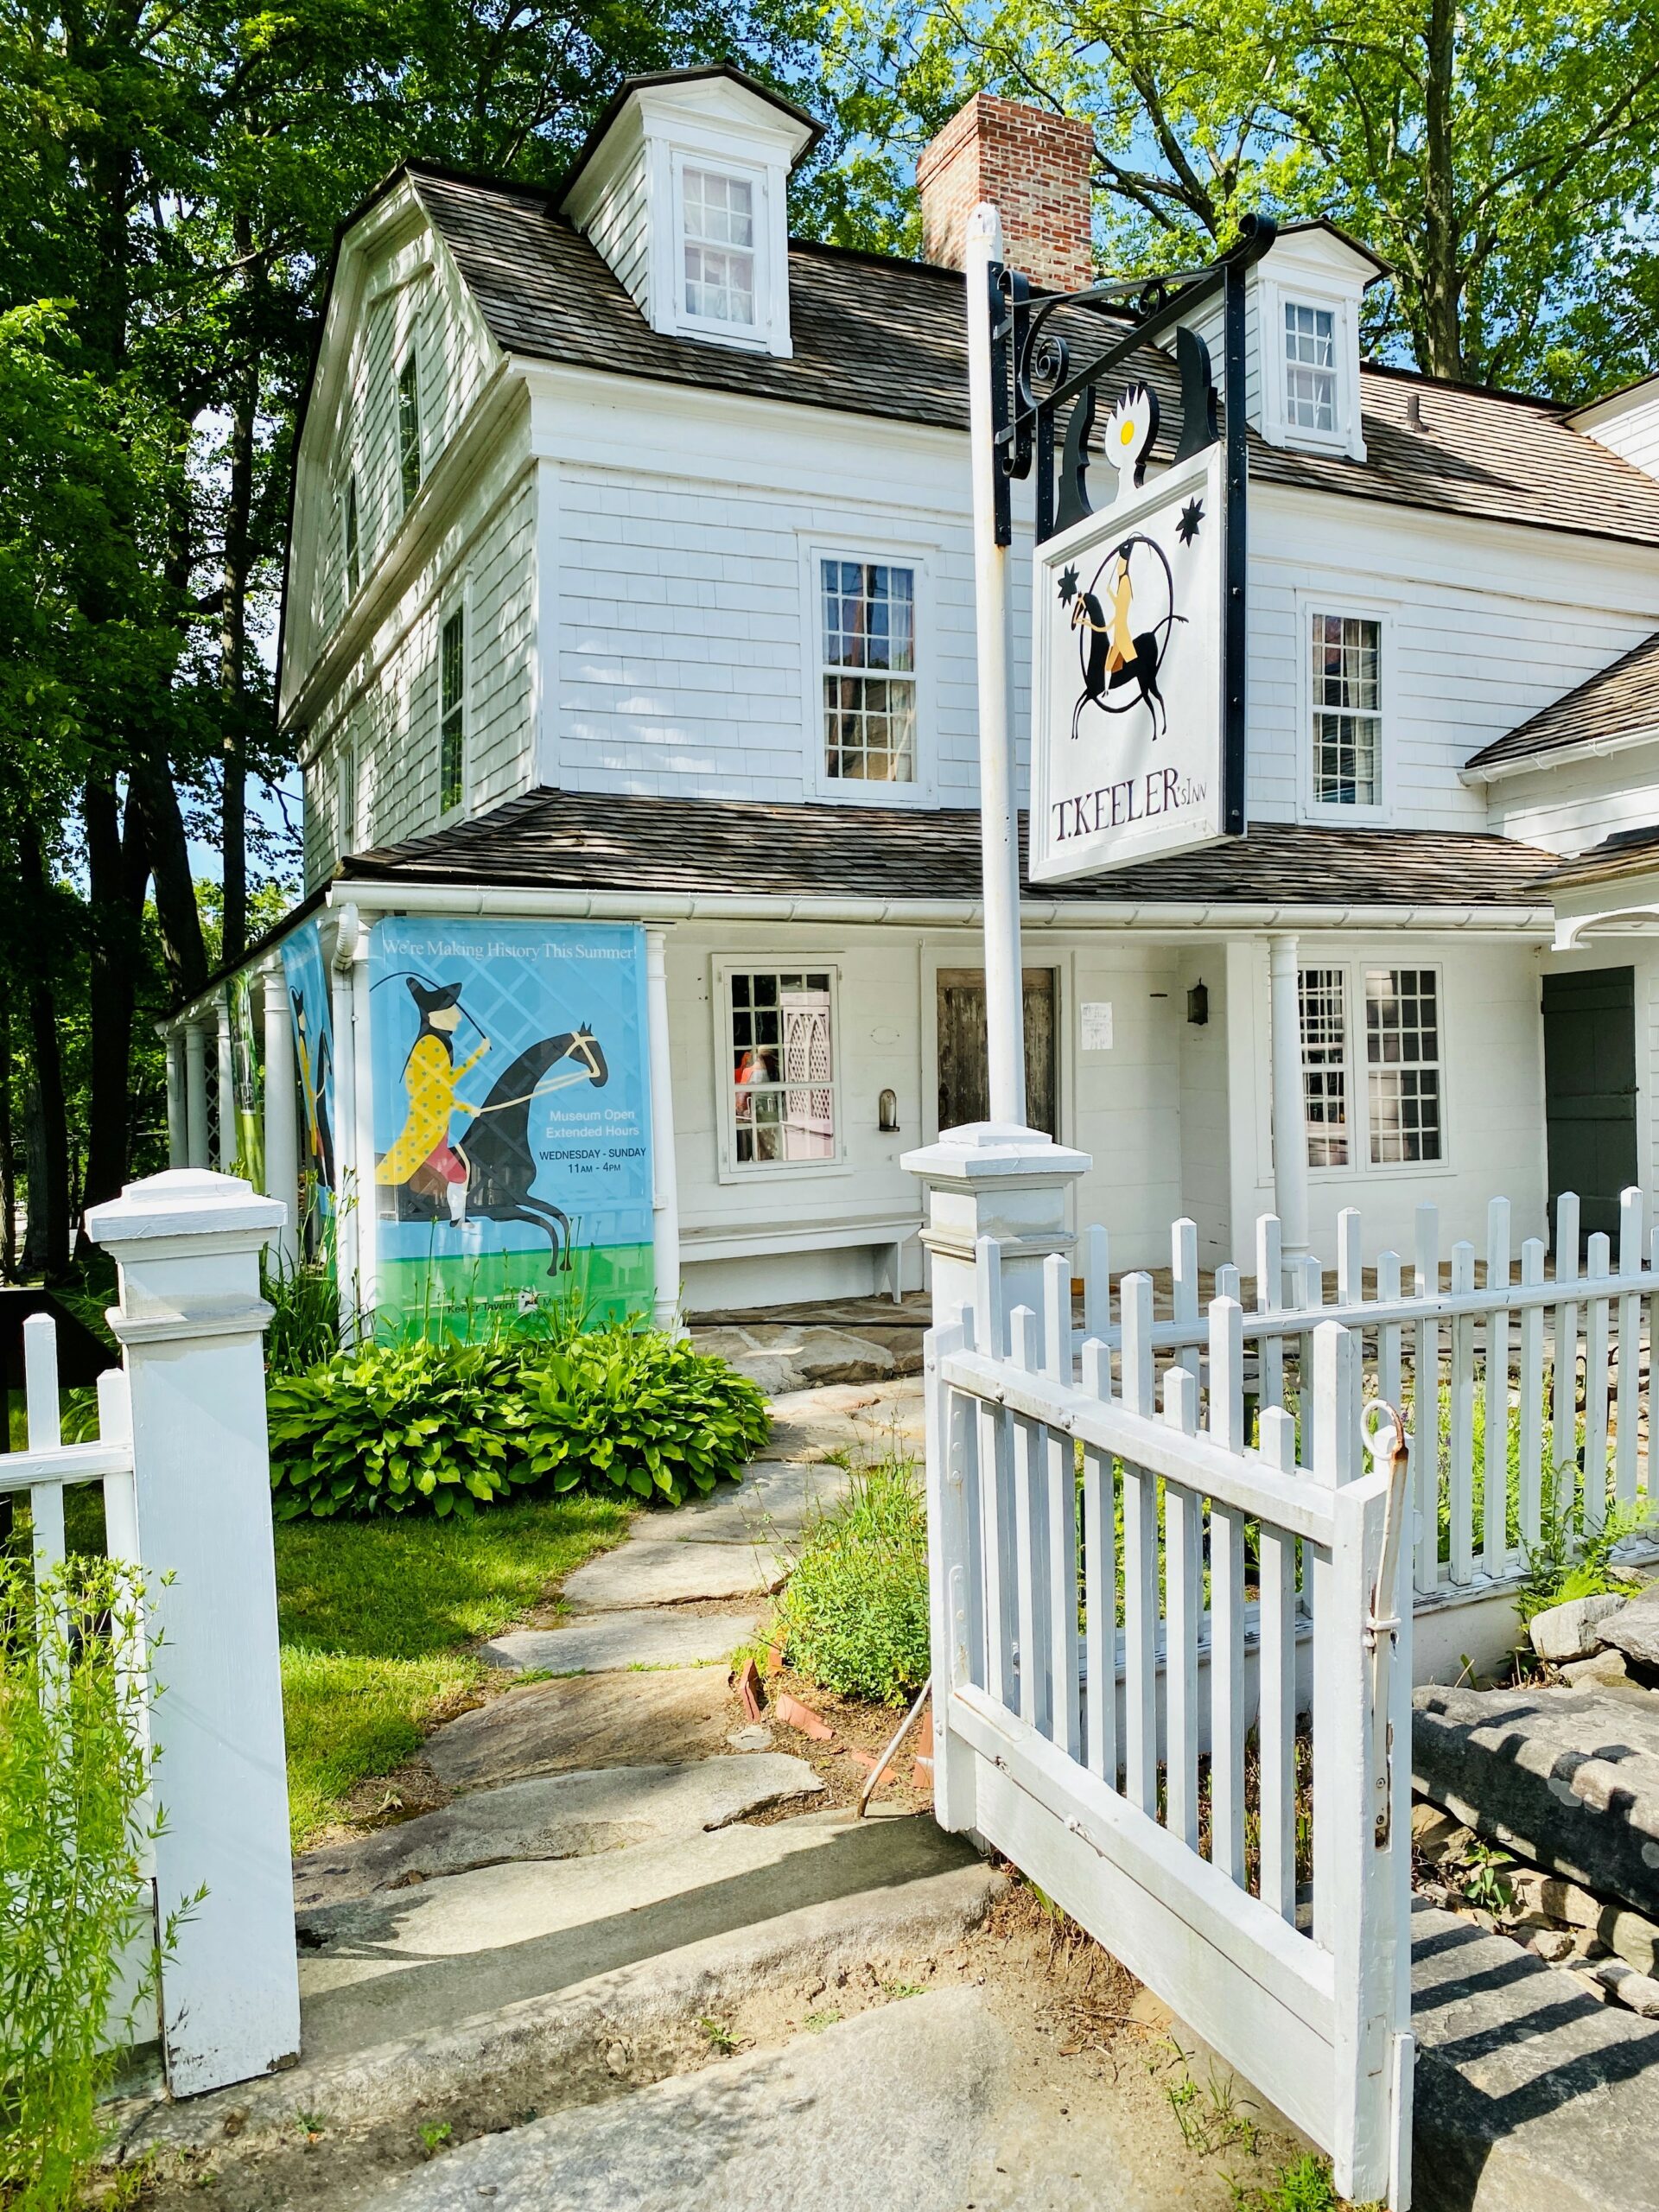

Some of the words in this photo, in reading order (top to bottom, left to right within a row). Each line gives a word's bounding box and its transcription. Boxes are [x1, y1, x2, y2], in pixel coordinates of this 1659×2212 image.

[384, 939, 424, 955] We're
[427, 940, 484, 961] Making
[487, 942, 540, 961] History
[542, 943, 573, 958] This
[575, 944, 637, 959] Summer!
[550, 1110, 601, 1122] Museum
[604, 1109, 635, 1122] Open
[546, 1126, 602, 1138] Extended
[606, 1125, 640, 1137] Hours
[539, 1150, 601, 1160] WEDNESDAY
[608, 1147, 646, 1158] SUNDAY
